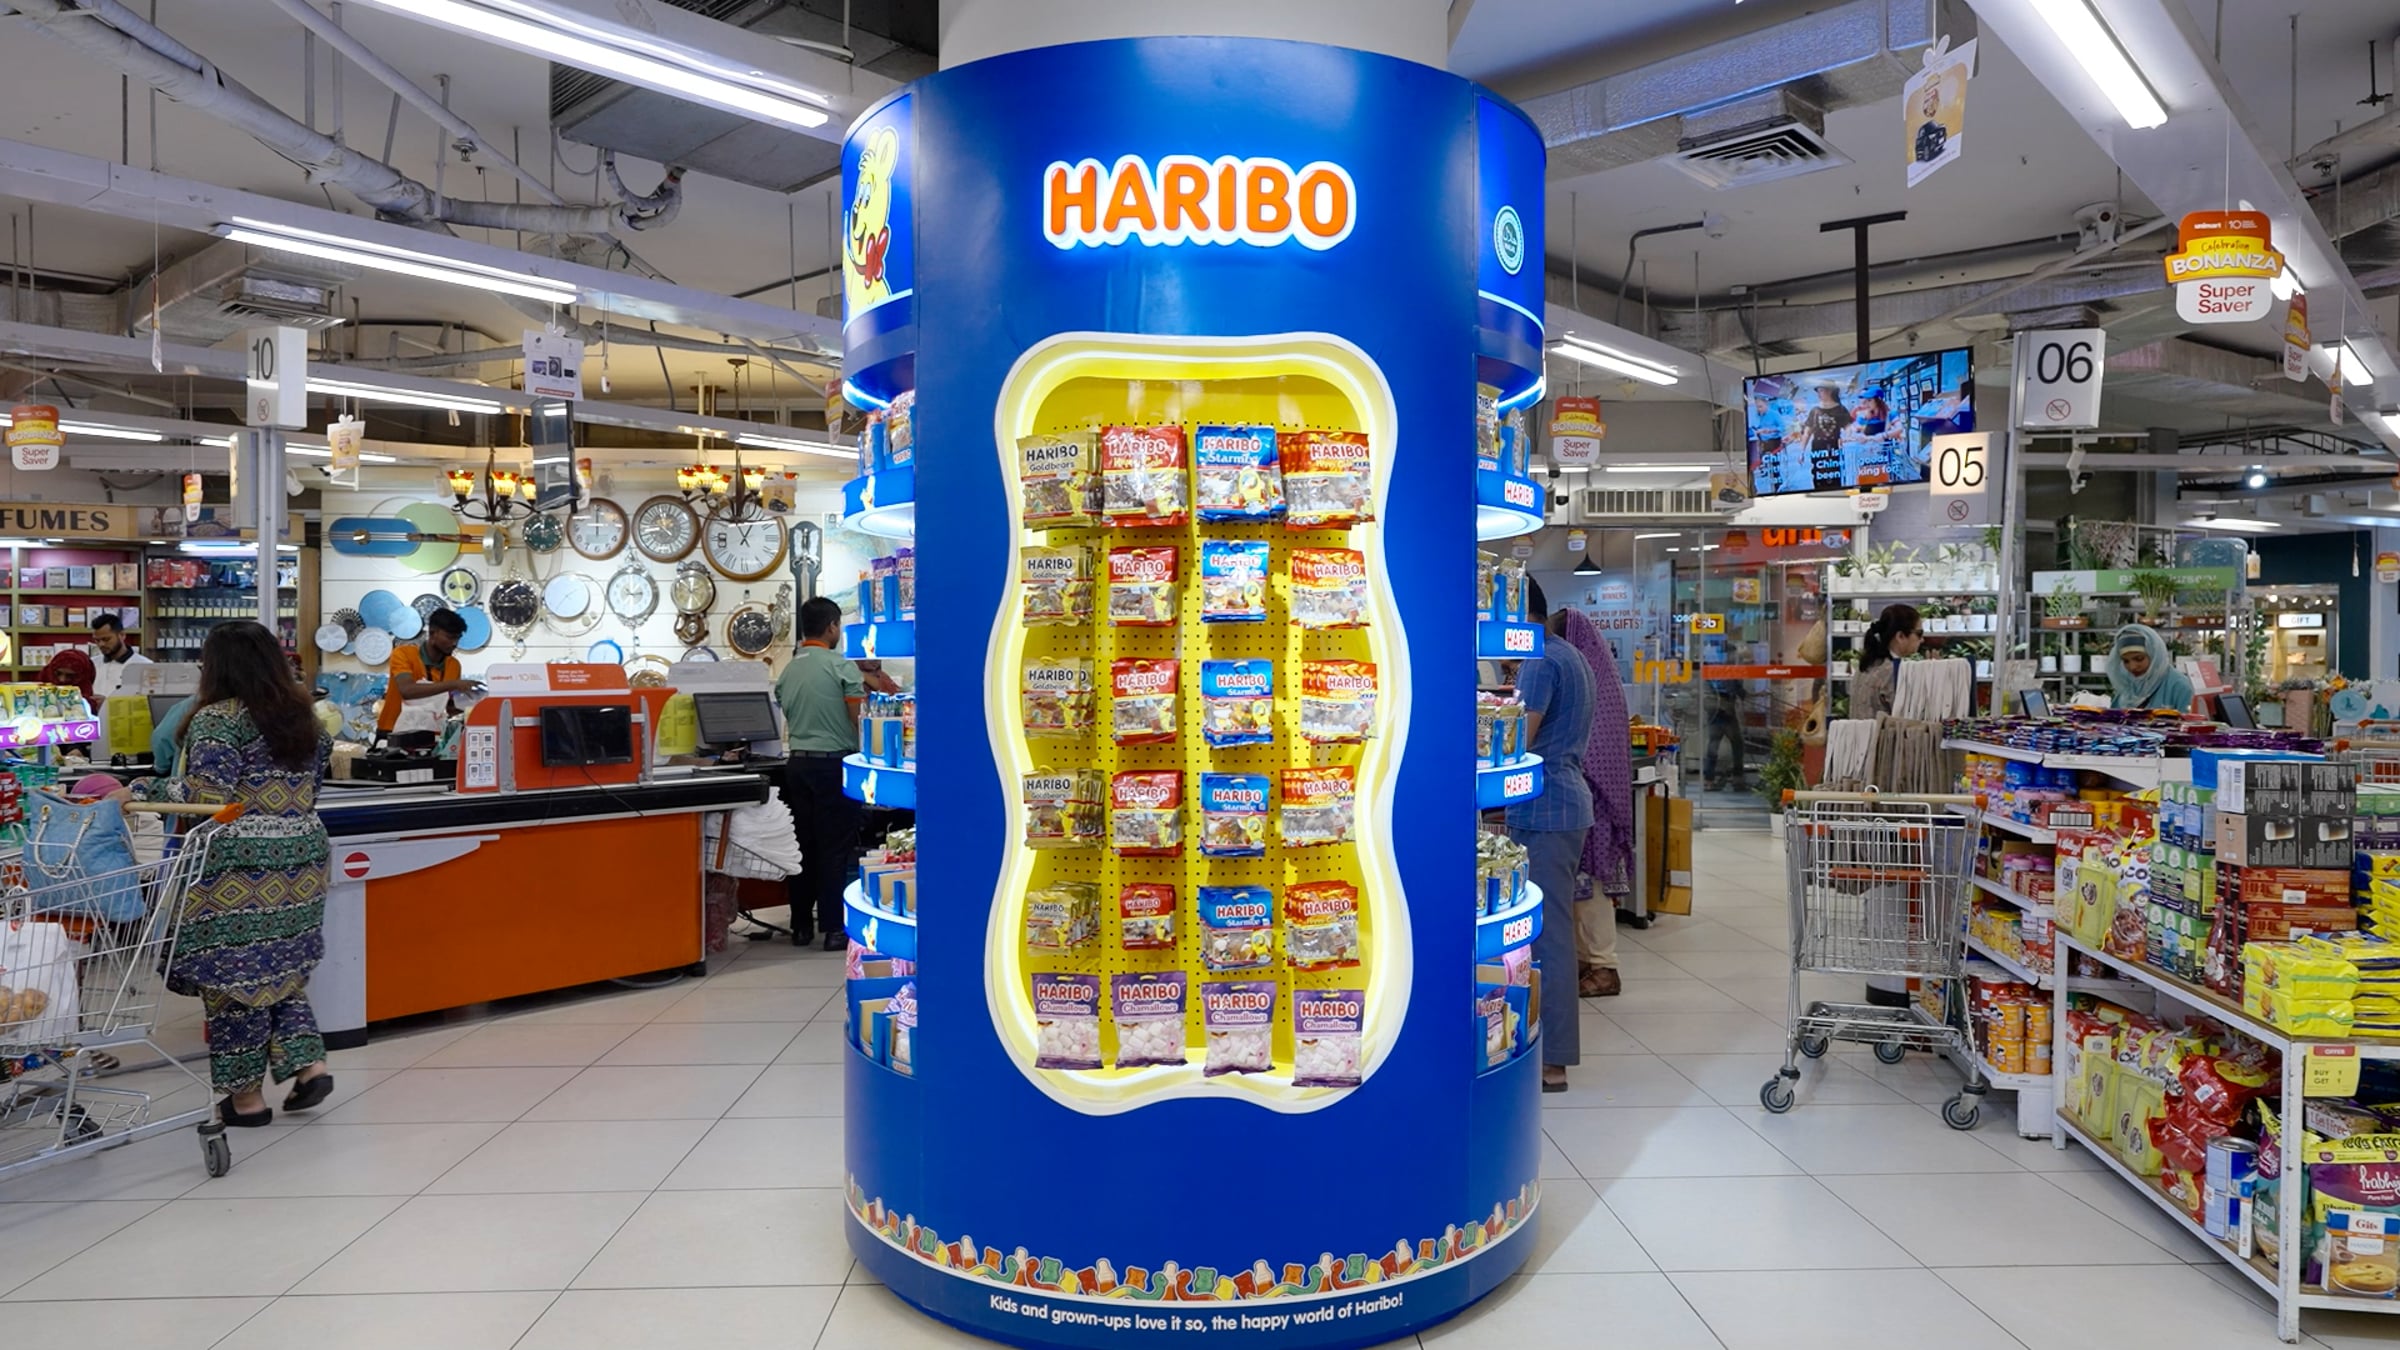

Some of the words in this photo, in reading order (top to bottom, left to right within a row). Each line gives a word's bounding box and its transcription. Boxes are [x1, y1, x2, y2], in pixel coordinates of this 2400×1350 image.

[1047, 157, 1352, 241] HARIBO
[2172, 253, 2278, 275] BONANZA
[2199, 284, 2255, 300] Super
[2198, 299, 2253, 313] Saver
[252, 337, 274, 380] 10
[2037, 341, 2094, 385] 06
[1108, 438, 1167, 457] HARIBO
[1203, 438, 1262, 452] HARIBO
[1563, 439, 1591, 450] Super
[22, 447, 49, 457] Super
[1026, 445, 1079, 462] HARIBO
[1311, 445, 1364, 461] HARIBO
[1563, 448, 1590, 458] Saver
[22, 456, 49, 465] Saver
[1029, 461, 1075, 472] Goldbears
[1939, 446, 1984, 487] 05
[1028, 558, 1073, 570] HARIBO
[1113, 560, 1165, 574] HARIBO
[1315, 564, 1361, 576] HARIBO
[2291, 616, 2310, 624] GIFT
[1029, 669, 1074, 681] HARIBO
[1118, 673, 1167, 688] HARIBO
[1217, 673, 1265, 687] HARIBO
[1328, 676, 1372, 689] HARIBO
[1026, 778, 1071, 790] HARIBO
[1305, 780, 1349, 794] HARIBO
[1213, 790, 1262, 802] HARIBO
[1126, 900, 1160, 910] HARIBO
[1217, 905, 1265, 918] HARIBO
[1305, 900, 1350, 915] HARIBO
[1039, 985, 1092, 1000] HARIBO
[1120, 984, 1179, 1000] HARIBO
[1040, 1003, 1090, 1013] Chamallows
[1122, 1003, 1177, 1013] Chamallows
[1210, 994, 1269, 1009] HARIBO
[1302, 1002, 1358, 1017] HARIBO
[1213, 1013, 1267, 1023] Chamallows
[1304, 1021, 1356, 1031] Chamallows
[2356, 1219, 2379, 1230] Gits
[990, 1295, 1018, 1313] Kids
[1021, 1304, 1048, 1319] and
[1051, 1309, 1131, 1331] grown-ups
[1135, 1314, 1167, 1330] love
[1171, 1315, 1182, 1330] it
[1185, 1317, 1208, 1332] so,
[1211, 1315, 1237, 1330] the
[1241, 1314, 1290, 1331] happy
[1293, 1305, 1334, 1325] world
[1338, 1303, 1353, 1318] of
[1355, 1292, 1403, 1316] Haribo!
